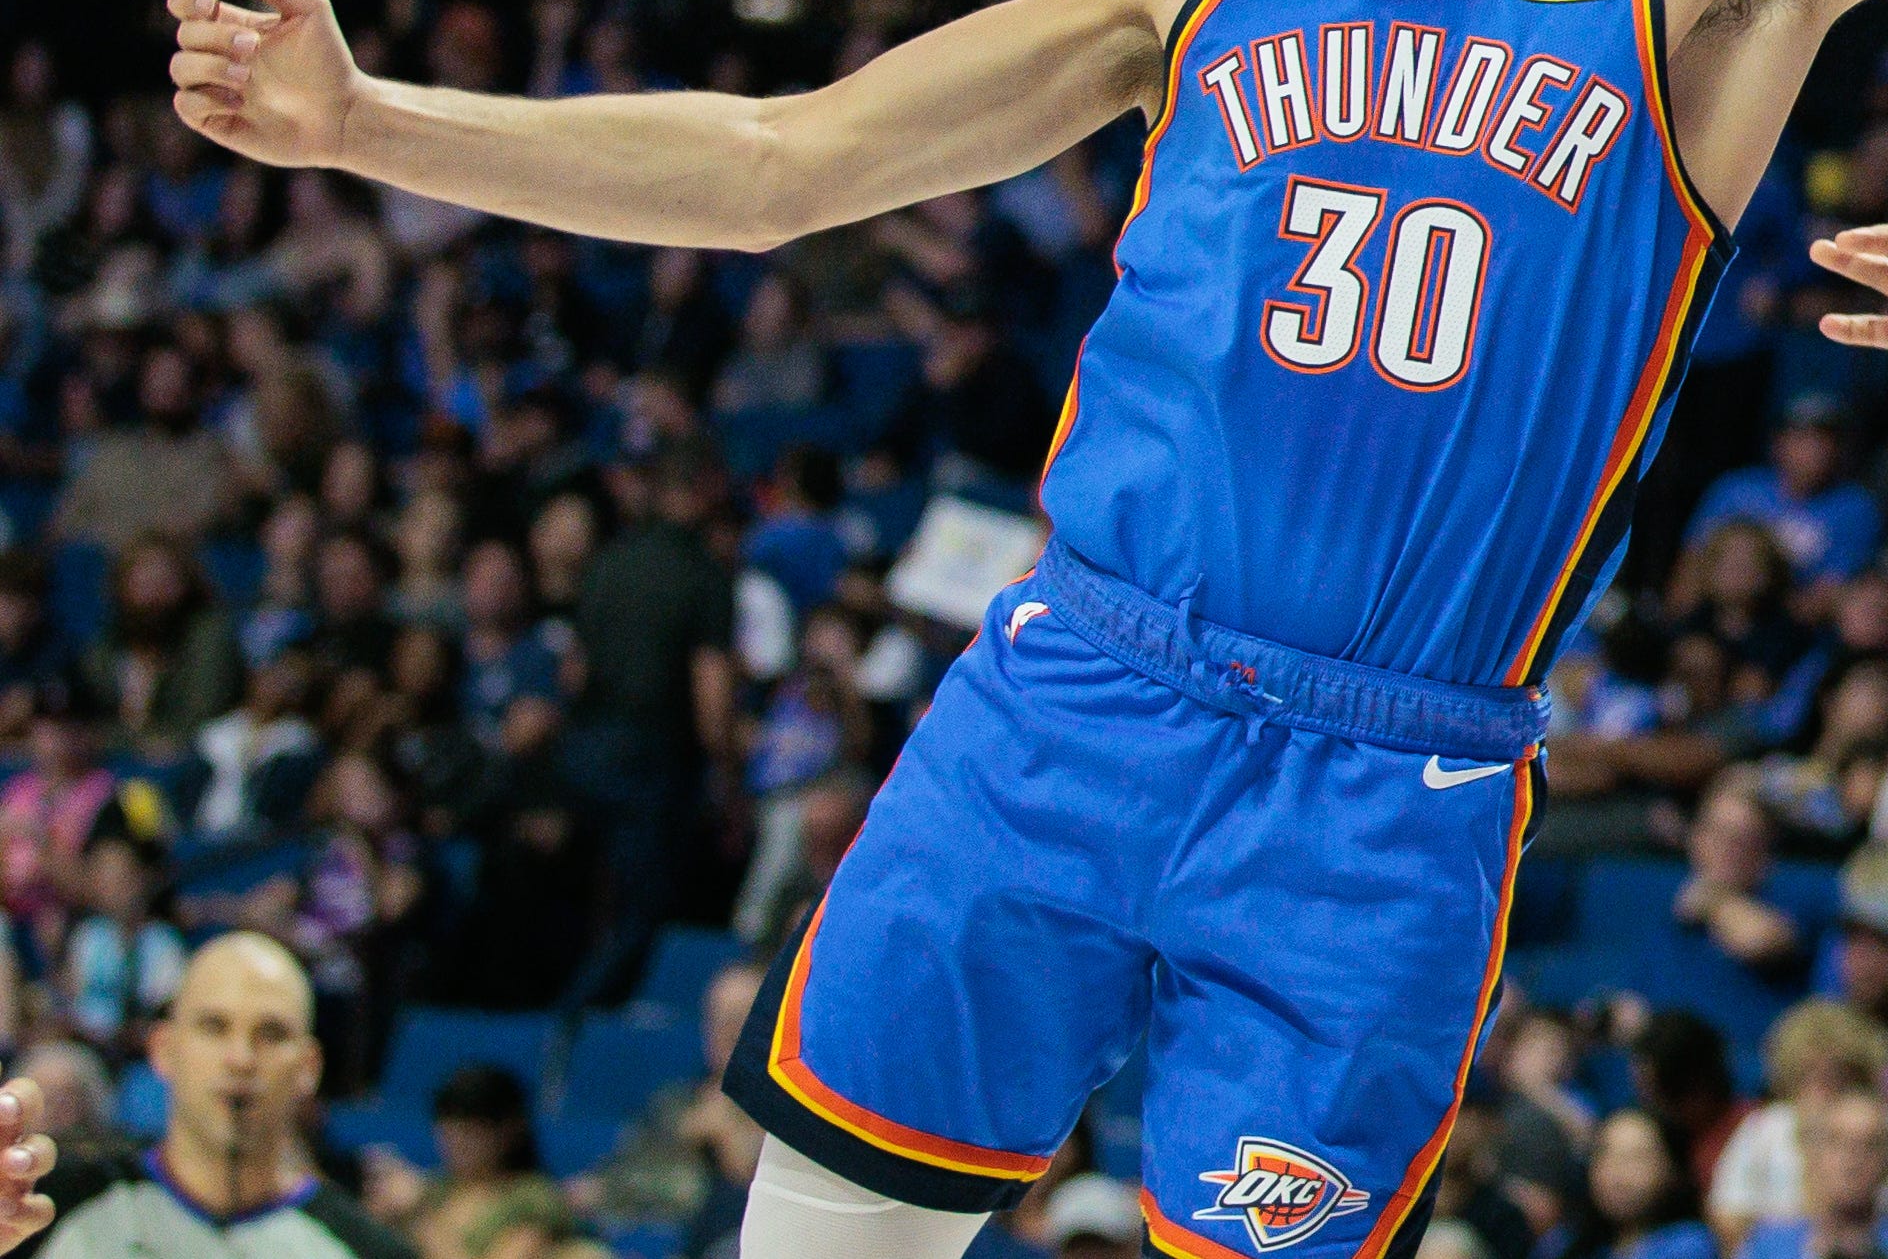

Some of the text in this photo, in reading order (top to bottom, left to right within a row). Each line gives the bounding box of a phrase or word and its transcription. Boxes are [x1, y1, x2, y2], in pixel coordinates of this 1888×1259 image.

[1199, 21, 1632, 214] THUNDER
[1260, 174, 1493, 393] 30
[1221, 1168, 1324, 1206] OKC
